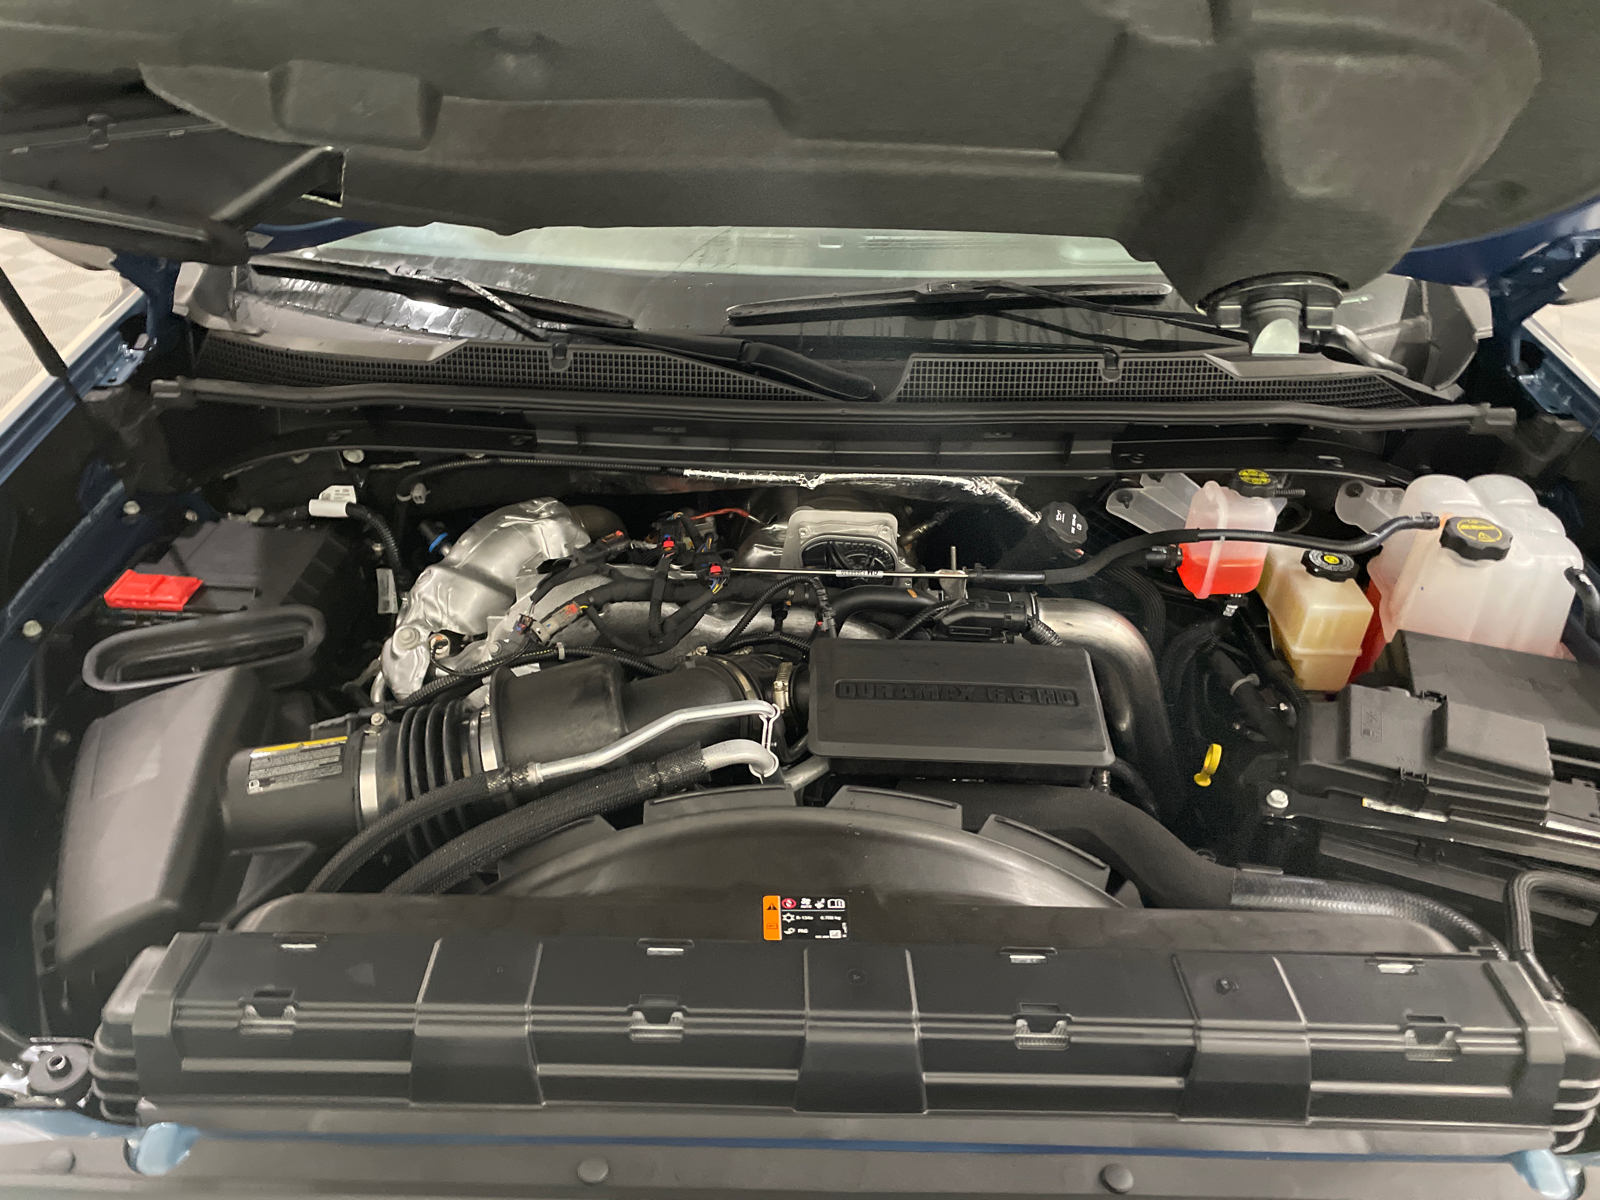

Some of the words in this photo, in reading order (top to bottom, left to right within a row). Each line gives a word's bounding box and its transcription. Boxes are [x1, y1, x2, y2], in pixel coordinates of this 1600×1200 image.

[843, 683, 974, 700] DURAMAX
[989, 688, 1031, 703] 6.6
[1038, 689, 1075, 705] HD
